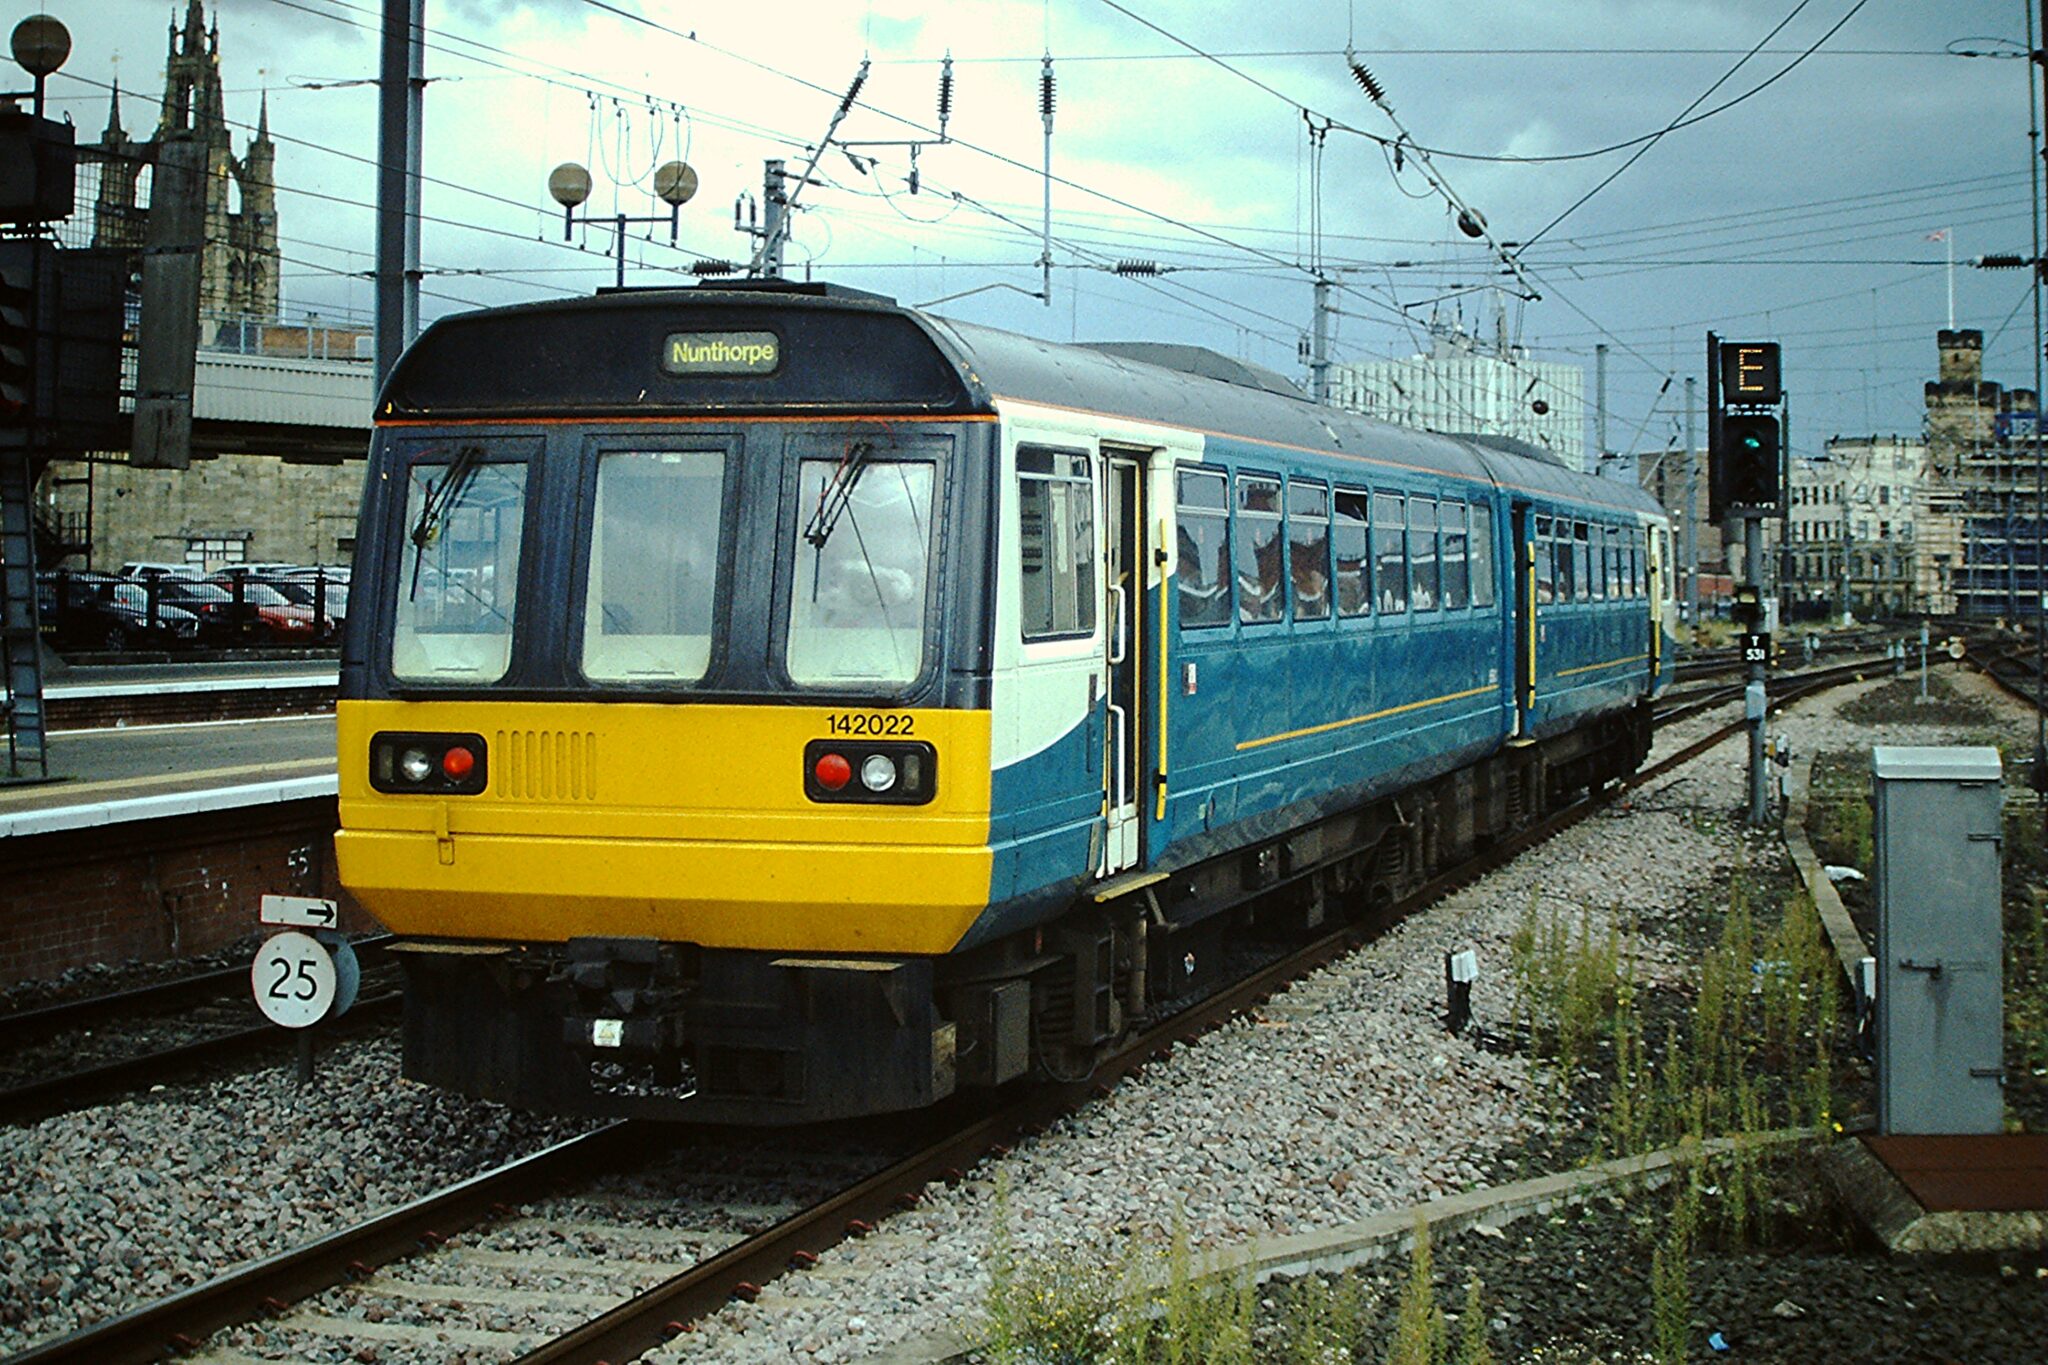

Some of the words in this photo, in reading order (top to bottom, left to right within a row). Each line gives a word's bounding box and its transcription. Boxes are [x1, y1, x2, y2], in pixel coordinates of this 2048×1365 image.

[672, 341, 774, 365] Nunthorpe
[1739, 349, 1764, 391] E
[1751, 635, 1759, 647] T
[827, 714, 914, 735] 142022
[268, 957, 317, 1001] 25
